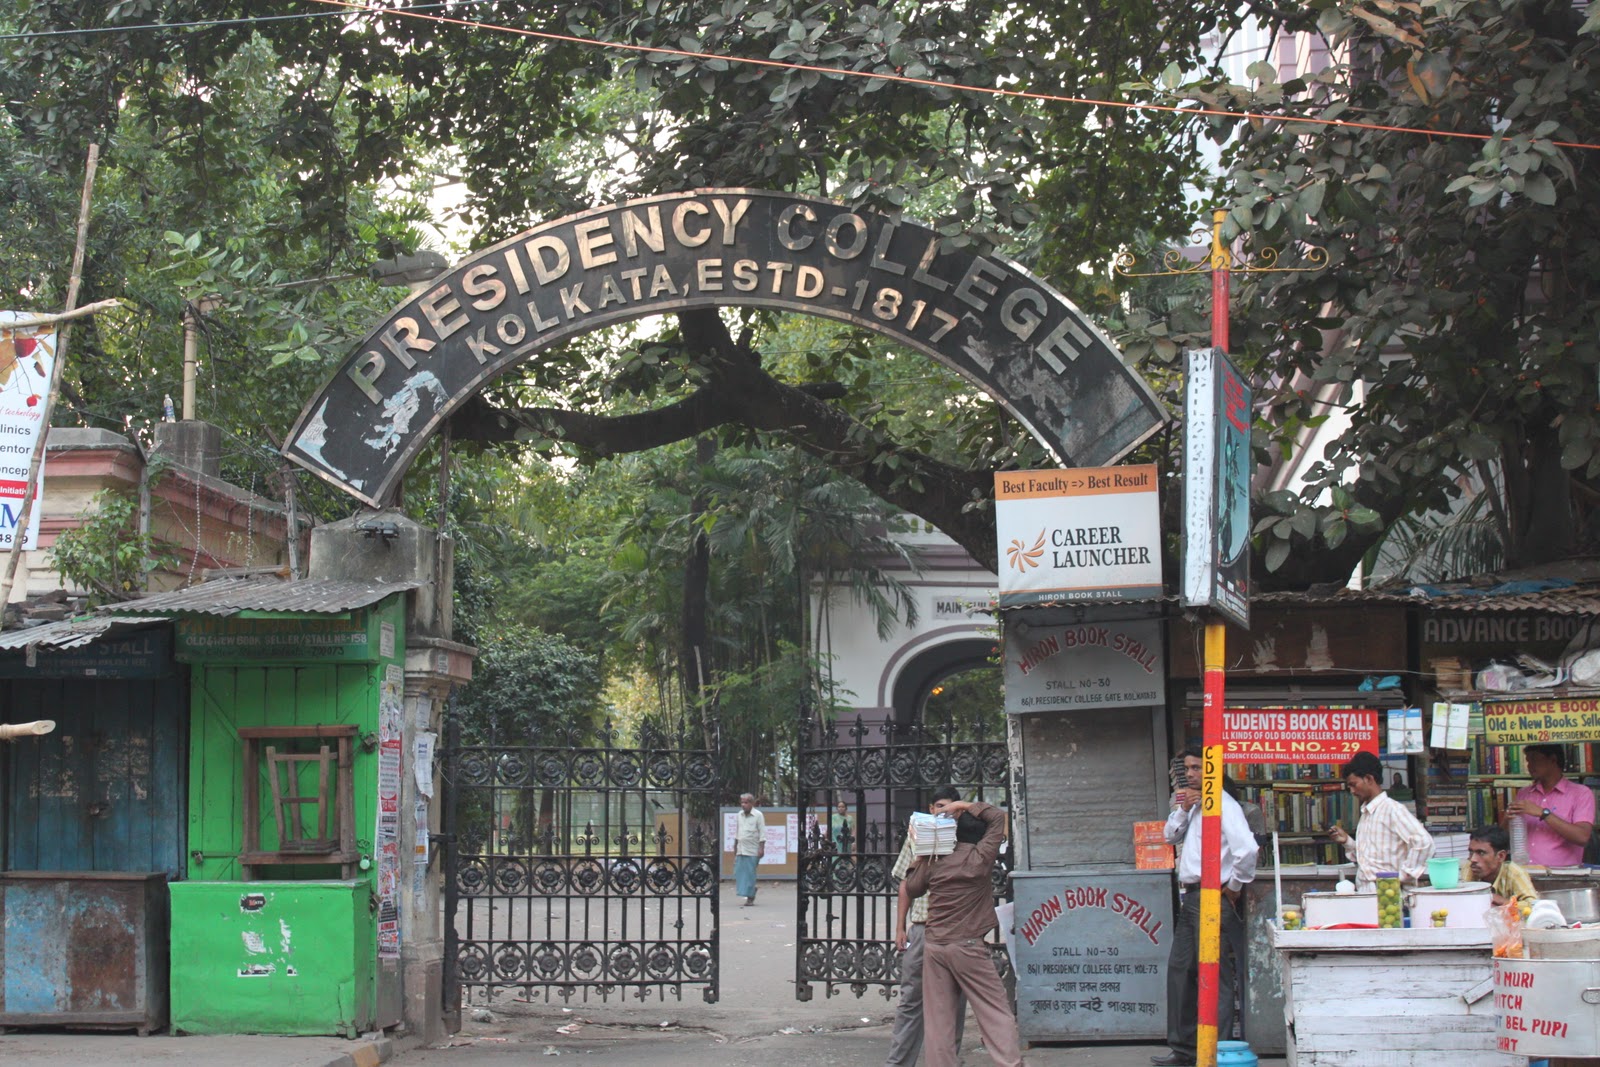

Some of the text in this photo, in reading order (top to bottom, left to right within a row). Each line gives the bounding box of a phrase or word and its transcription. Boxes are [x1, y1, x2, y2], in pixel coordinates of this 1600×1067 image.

[346, 198, 1093, 405] PRESIDENCY COLLEGE
[0, 424, 31, 435] linics
[0, 444, 31, 454] entor
[1003, 480, 1026, 494] Best
[1029, 478, 1069, 494] Faculty
[1088, 475, 1111, 489] Best
[1114, 473, 1148, 487] Result
[1051, 526, 1122, 547] CAREER
[1052, 547, 1151, 569] LAUNCHER
[1068, 592, 1093, 600] BOOK
[936, 601, 962, 614] MAIN
[1424, 616, 1580, 642] ADVANCE BOO
[1017, 627, 1157, 676] HIRON BOOK STALL
[1046, 678, 1111, 690] STALL NO-30
[1035, 696, 1072, 705] PRESIDENCY
[1074, 694, 1102, 703] COLLEGE
[1485, 699, 1599, 717] ADVANCE BOOK
[1223, 713, 1286, 730] TUDENTS
[1290, 713, 1329, 731] BOOK
[1332, 713, 1374, 731] STALL
[1488, 717, 1507, 731] Old
[1519, 716, 1543, 730] New
[1544, 714, 1578, 729] Books
[1231, 731, 1253, 740] KINDS
[1254, 731, 1263, 740] OF
[1264, 731, 1279, 740] OLD
[1281, 731, 1306, 740] BOOKS
[1307, 731, 1335, 740] SELLERS
[1336, 731, 1342, 740] &
[1343, 731, 1371, 740] BUYERS
[1498, 733, 1525, 742] STALL
[1551, 730, 1592, 740] PRESIDENCY
[1227, 741, 1286, 752] STALL
[1291, 741, 1326, 752] NO.
[1341, 741, 1360, 753] 29
[1020, 886, 1162, 946] HIRON BOOK STALL
[1052, 946, 1119, 957] STALL NO-30
[1042, 964, 1080, 975] PRESIDENCY
[1082, 964, 1112, 975] COLLEGE
[1503, 971, 1535, 988] MURI
[1079, 996, 1104, 1013] বই
[1505, 1015, 1527, 1032] BEL
